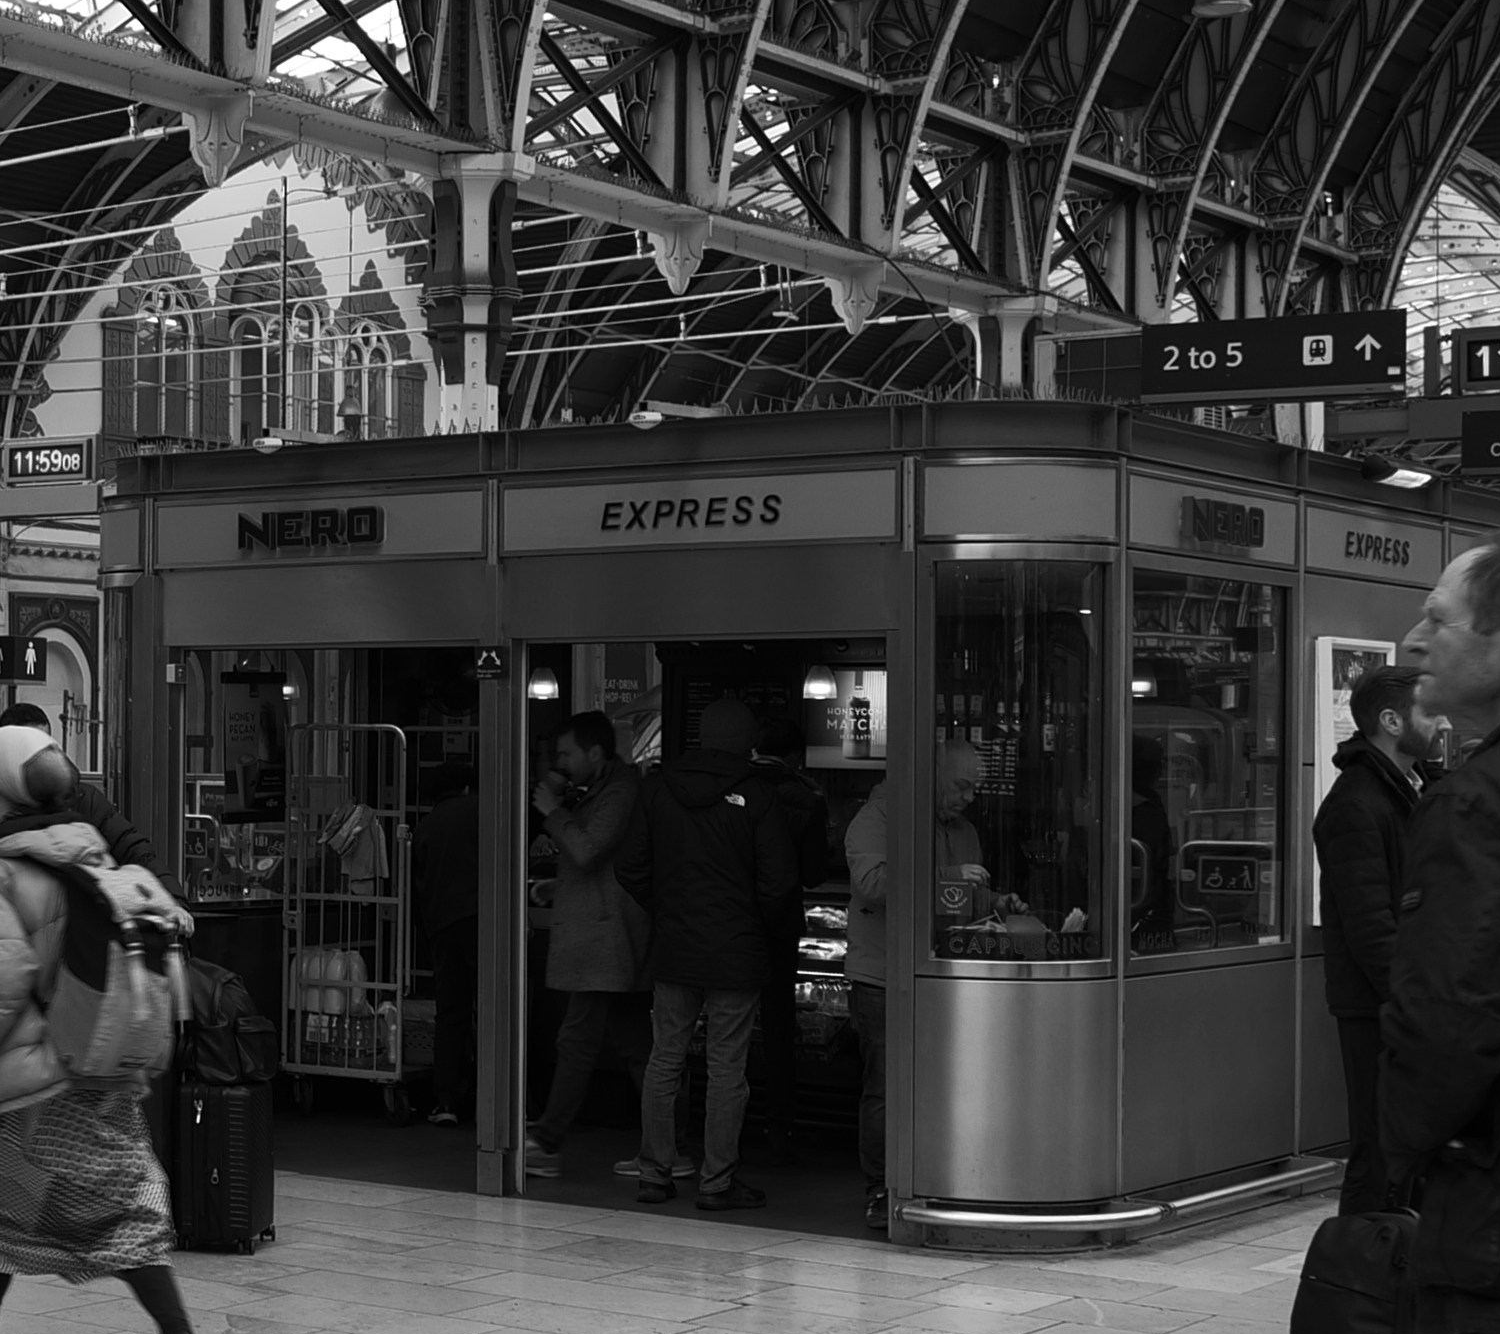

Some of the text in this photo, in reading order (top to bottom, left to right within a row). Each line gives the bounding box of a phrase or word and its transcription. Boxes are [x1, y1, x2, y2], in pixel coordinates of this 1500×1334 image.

[1162, 341, 1243, 371] 2 to 5
[238, 506, 385, 550] NERO
[601, 494, 782, 530] EXPRESS
[1182, 496, 1264, 548] NERO
[1345, 530, 1410, 566] EXPRESS
[229, 712, 256, 722] HONEY
[229, 724, 256, 734] PECAN
[1138, 930, 1175, 951] MOCHA
